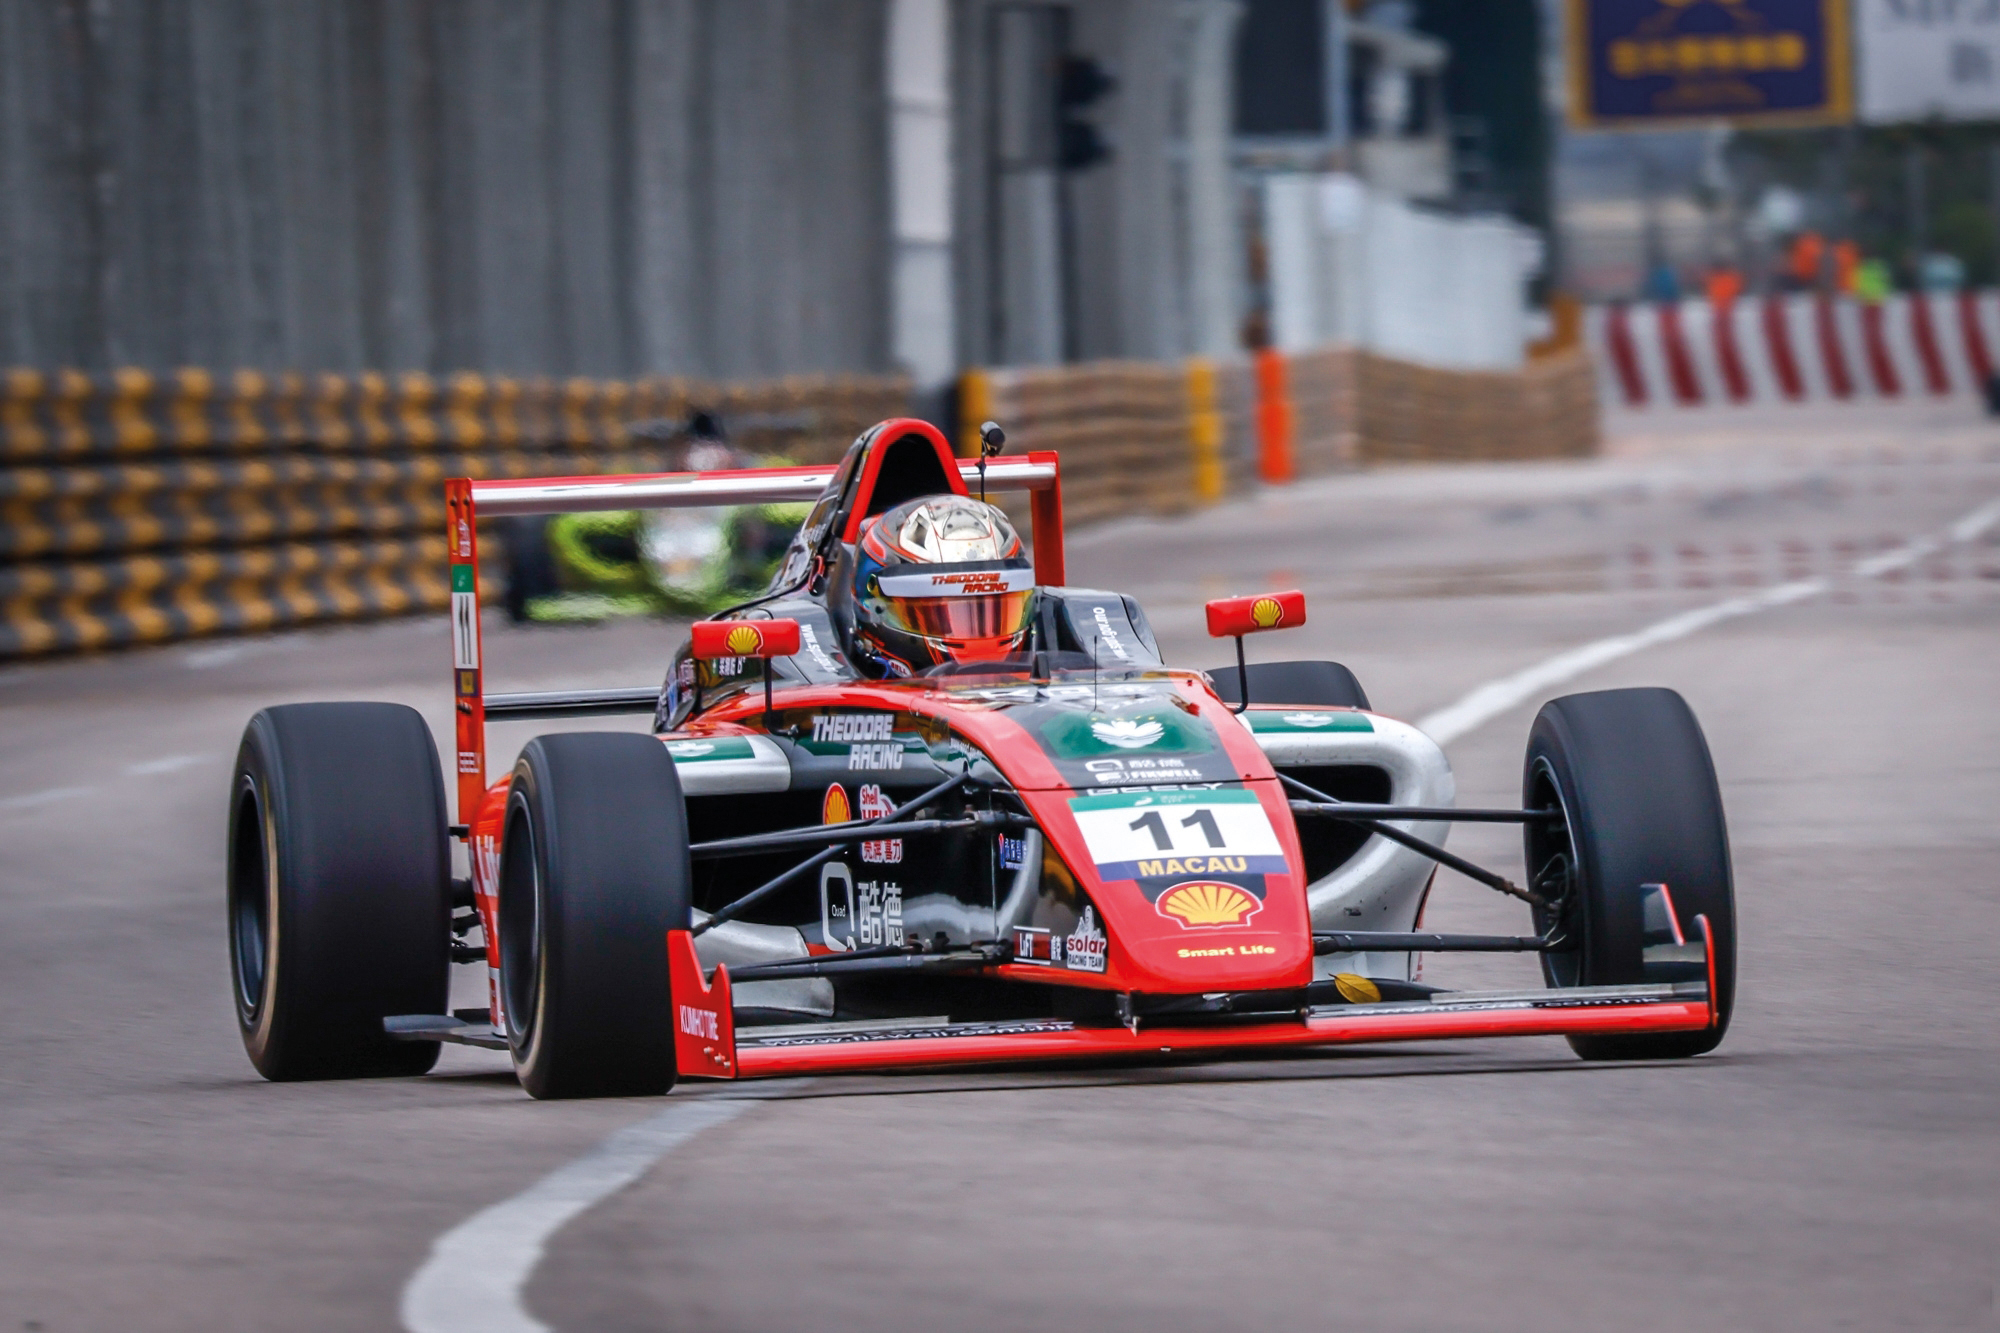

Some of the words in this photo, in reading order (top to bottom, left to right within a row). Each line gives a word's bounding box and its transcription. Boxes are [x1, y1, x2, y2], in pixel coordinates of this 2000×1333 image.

[932, 572, 1001, 586] THEODORE
[962, 581, 1009, 594] RACING
[812, 713, 895, 742] THEODORE
[849, 744, 904, 770] RACING
[862, 786, 878, 805] Shell
[1129, 809, 1227, 851] 11
[1138, 856, 1248, 877] MACAU
[831, 904, 846, 917] Quad
[857, 880, 904, 946] 酷德
[1067, 935, 1105, 955] solar
[1177, 946, 1235, 959] Smart
[1239, 944, 1275, 955] Life
[1068, 953, 1087, 968] RACING
[1088, 955, 1104, 969] TEAM
[679, 1004, 705, 1038] KUMHO
